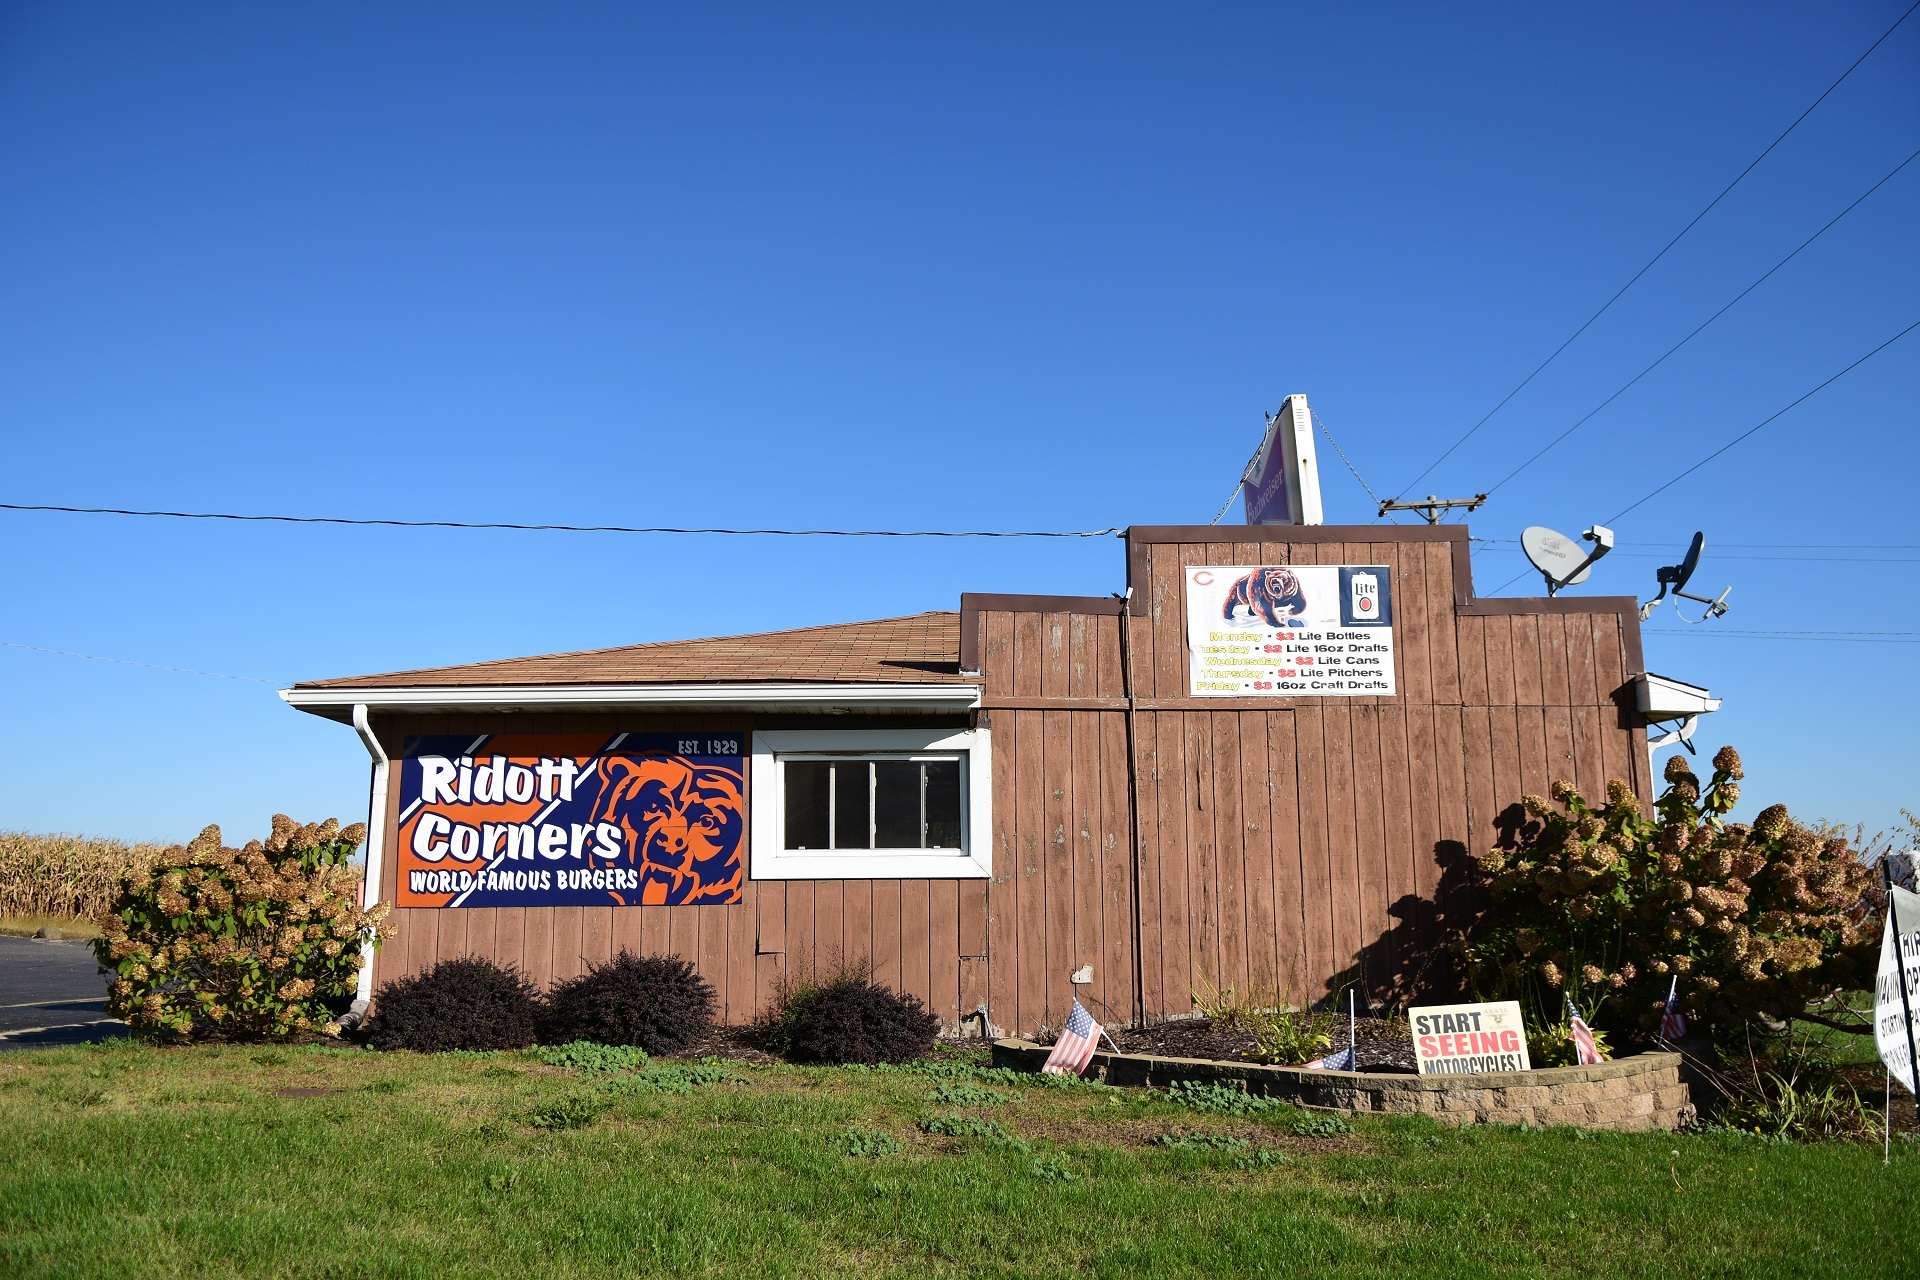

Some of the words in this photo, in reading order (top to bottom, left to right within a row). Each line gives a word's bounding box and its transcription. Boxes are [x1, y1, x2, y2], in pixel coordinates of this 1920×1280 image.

[1355, 583, 1376, 597] Lite
[1298, 632, 1322, 641] Lite
[1326, 632, 1371, 641] Bottles
[1286, 644, 1310, 653] Lite
[1314, 644, 1344, 653] 16oz
[1348, 644, 1389, 653] Drafts
[1205, 657, 1281, 667] Wednesday
[1318, 656, 1341, 665] Lite
[1345, 656, 1380, 665] Cans
[1300, 669, 1324, 677] Lite
[1328, 668, 1383, 677] Pitchers
[1196, 681, 1240, 691] Friday
[1276, 681, 1307, 690] 16oz
[1311, 681, 1344, 690] Craft
[1348, 681, 1389, 689] Drafts
[678, 740, 700, 755] EST.
[707, 740, 738, 754] 1929
[417, 754, 578, 804] Ridott
[413, 812, 623, 862] Corners
[410, 869, 476, 893] WORLD
[477, 868, 551, 892] FAMOUS
[556, 867, 639, 891] BURGERS
[1415, 1011, 1482, 1036] START
[1418, 1029, 1520, 1058] SEEING
